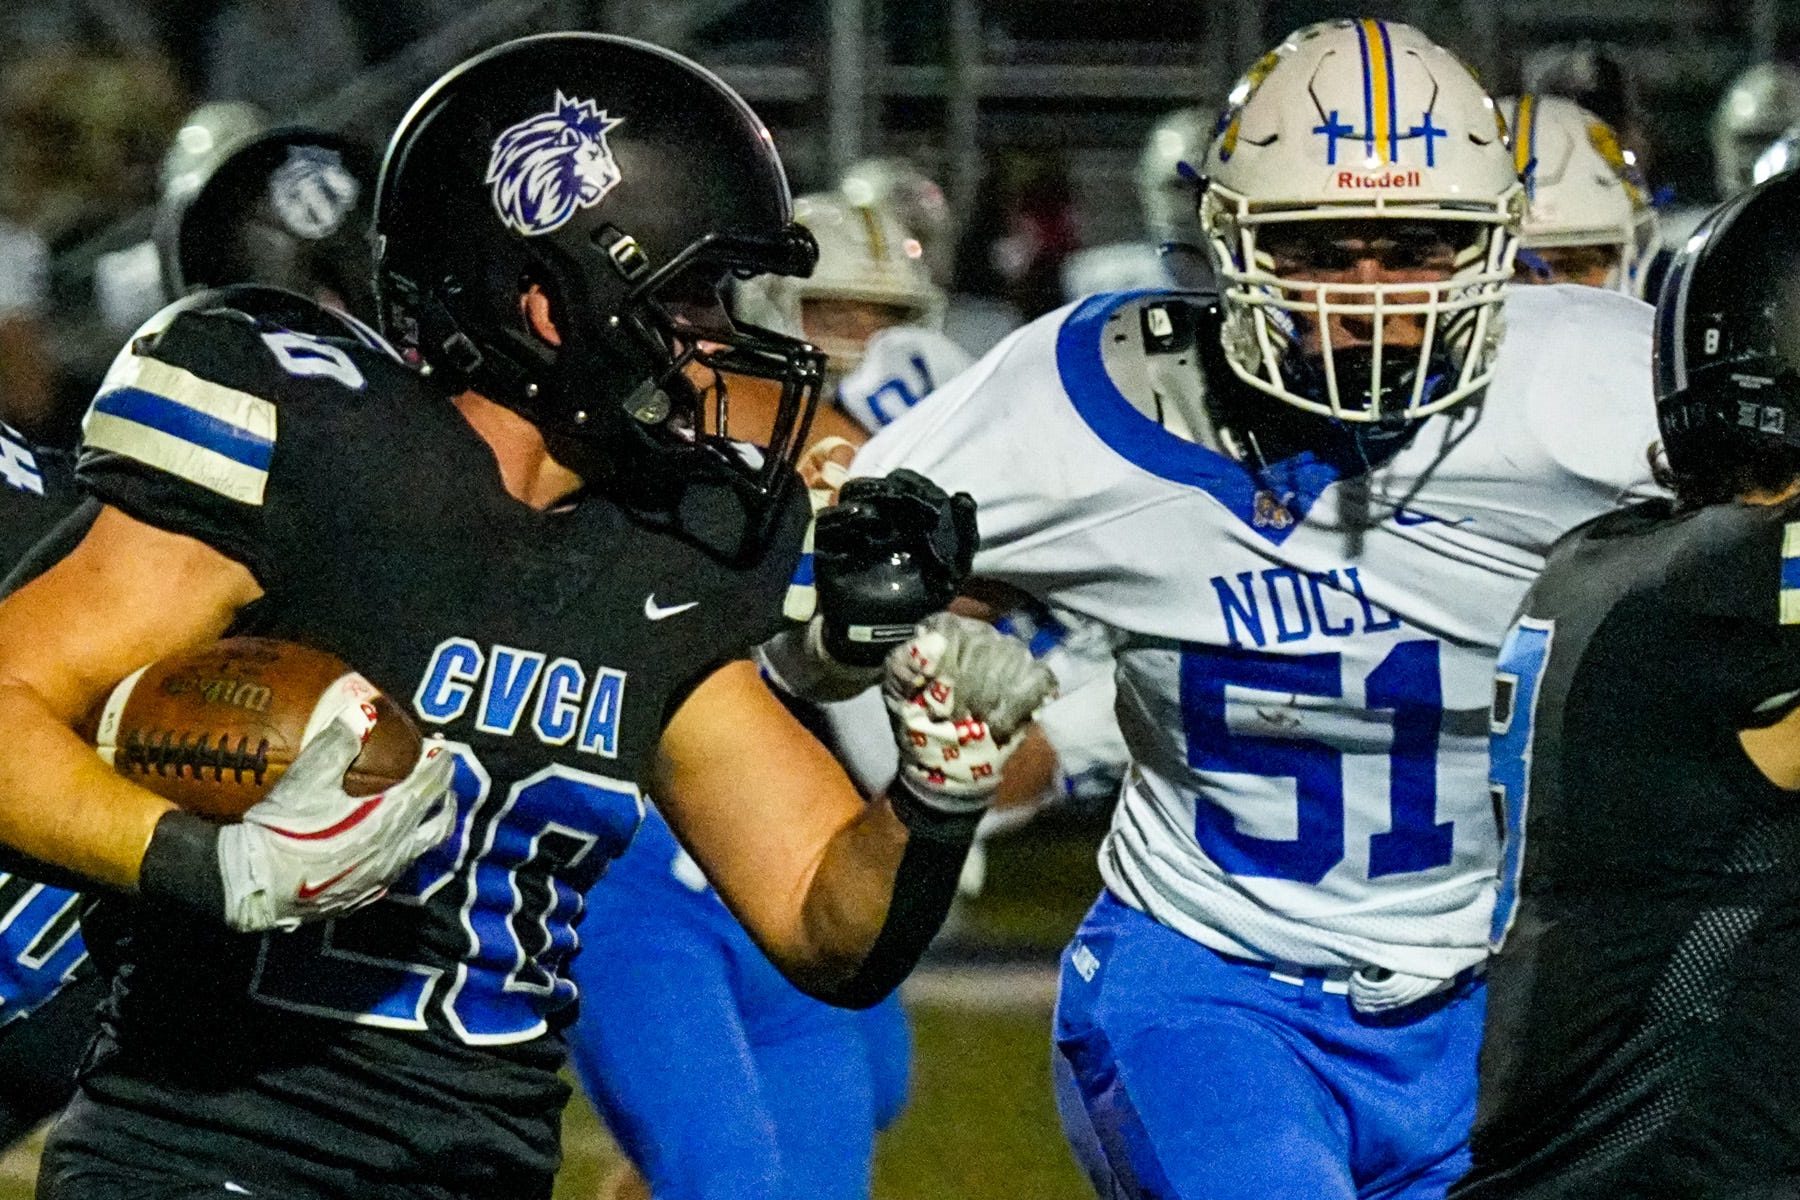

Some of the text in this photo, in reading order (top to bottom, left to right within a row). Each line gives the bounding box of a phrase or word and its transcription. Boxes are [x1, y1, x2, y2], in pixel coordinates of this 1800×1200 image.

[1337, 170, 1421, 189] Riddell
[1209, 565, 1402, 652] NDCL
[413, 635, 628, 760] CVCA
[1179, 638, 1455, 886] 51
[248, 739, 648, 1047] 20
